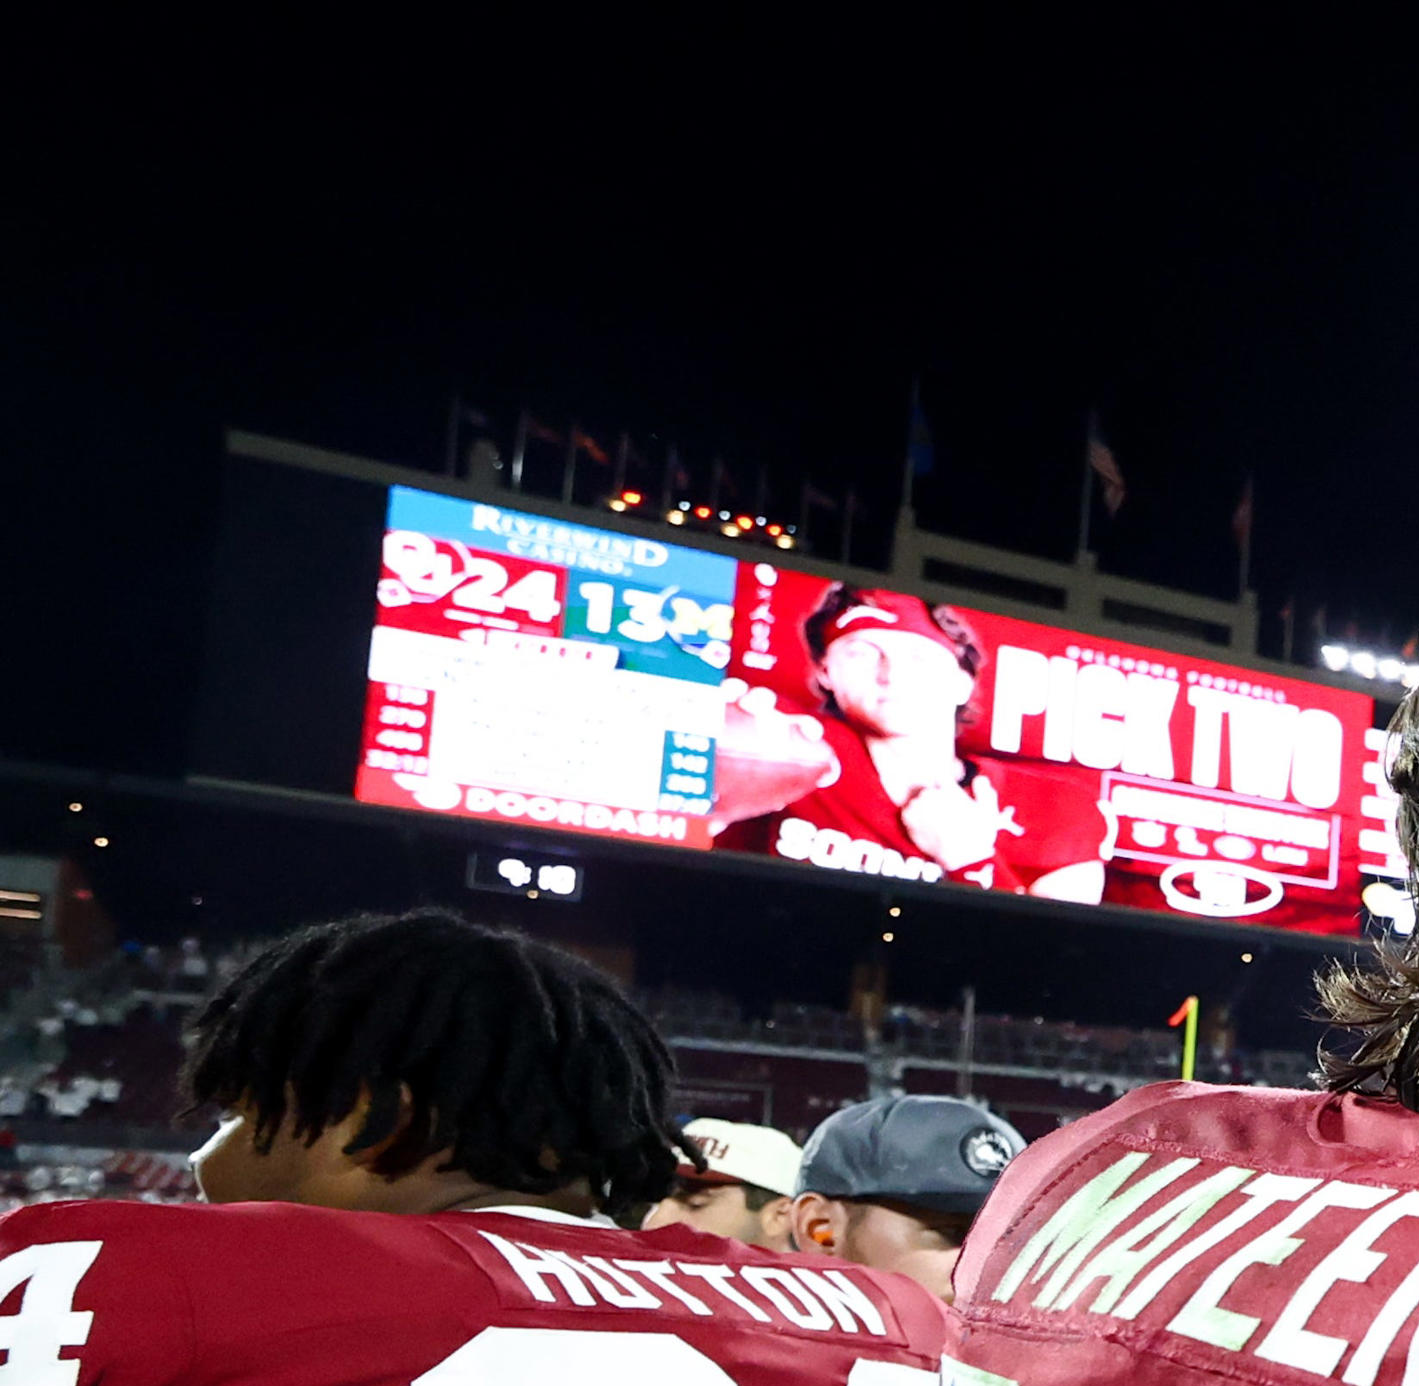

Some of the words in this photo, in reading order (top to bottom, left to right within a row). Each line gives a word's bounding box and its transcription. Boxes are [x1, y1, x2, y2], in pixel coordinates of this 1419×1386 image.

[472, 504, 669, 567] RIVERWIND
[507, 538, 625, 575] CASINO
[452, 557, 561, 623] 24
[579, 582, 667, 643] 13
[990, 645, 1179, 780] PICK
[1187, 685, 1343, 808] TWO
[466, 787, 687, 840] DOORDASH
[477, 1230, 888, 1336] HUTTON
